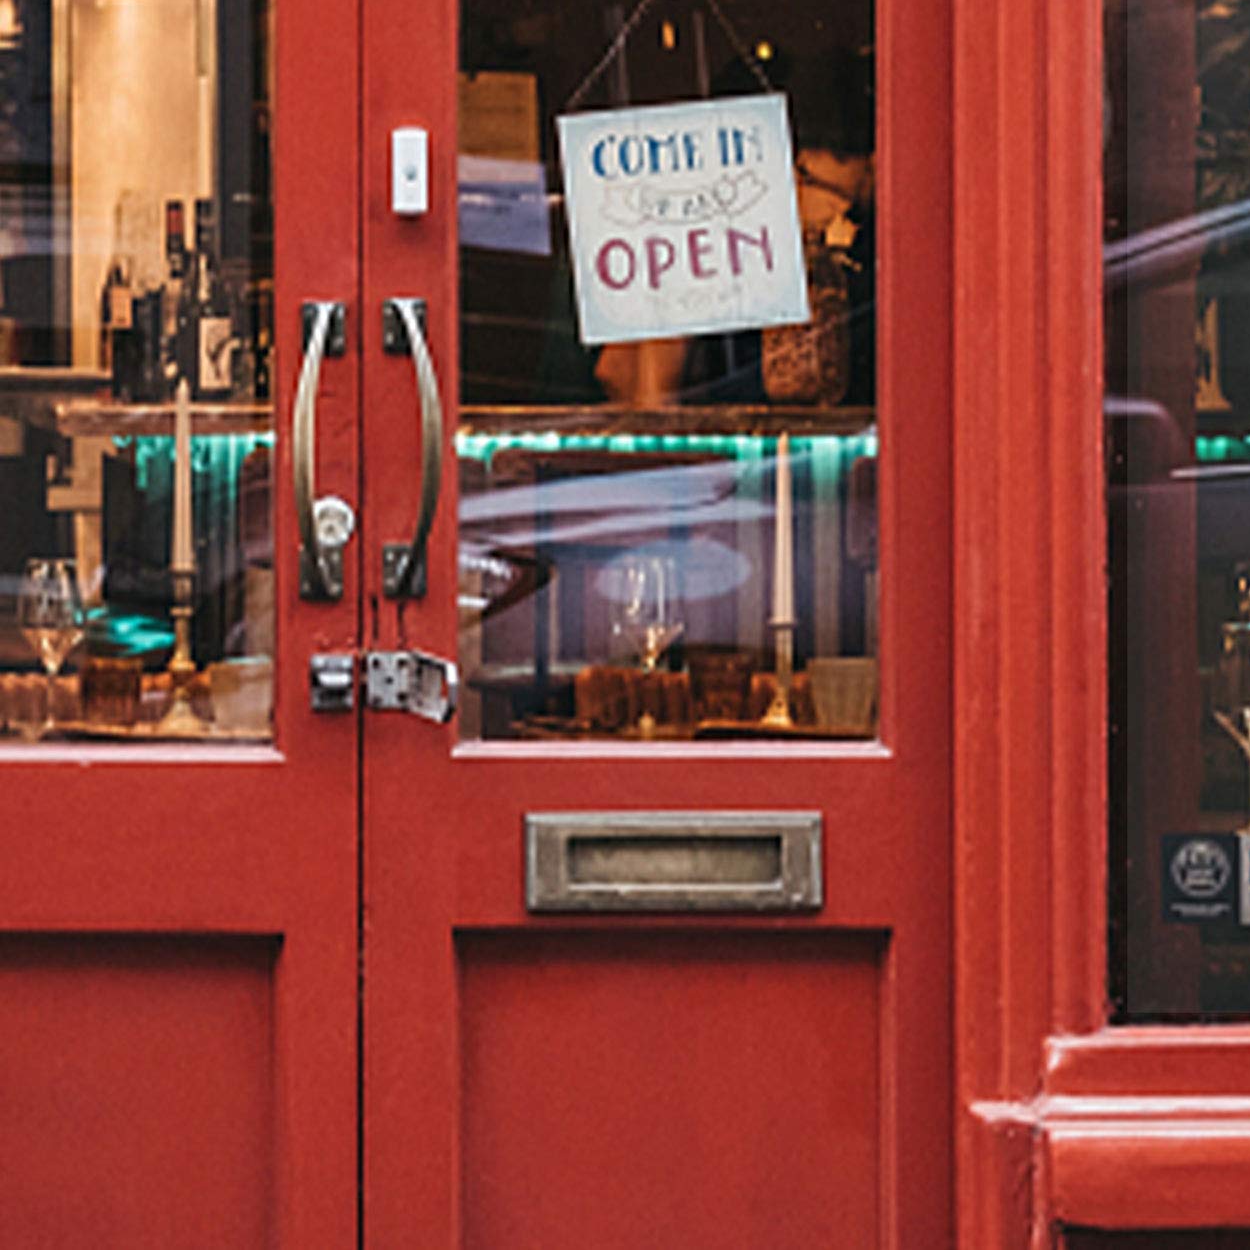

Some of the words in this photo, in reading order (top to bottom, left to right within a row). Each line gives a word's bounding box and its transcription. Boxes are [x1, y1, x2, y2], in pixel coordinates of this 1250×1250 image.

[592, 130, 704, 180] COME
[717, 126, 763, 168] IN
[596, 226, 774, 291] OPEN
